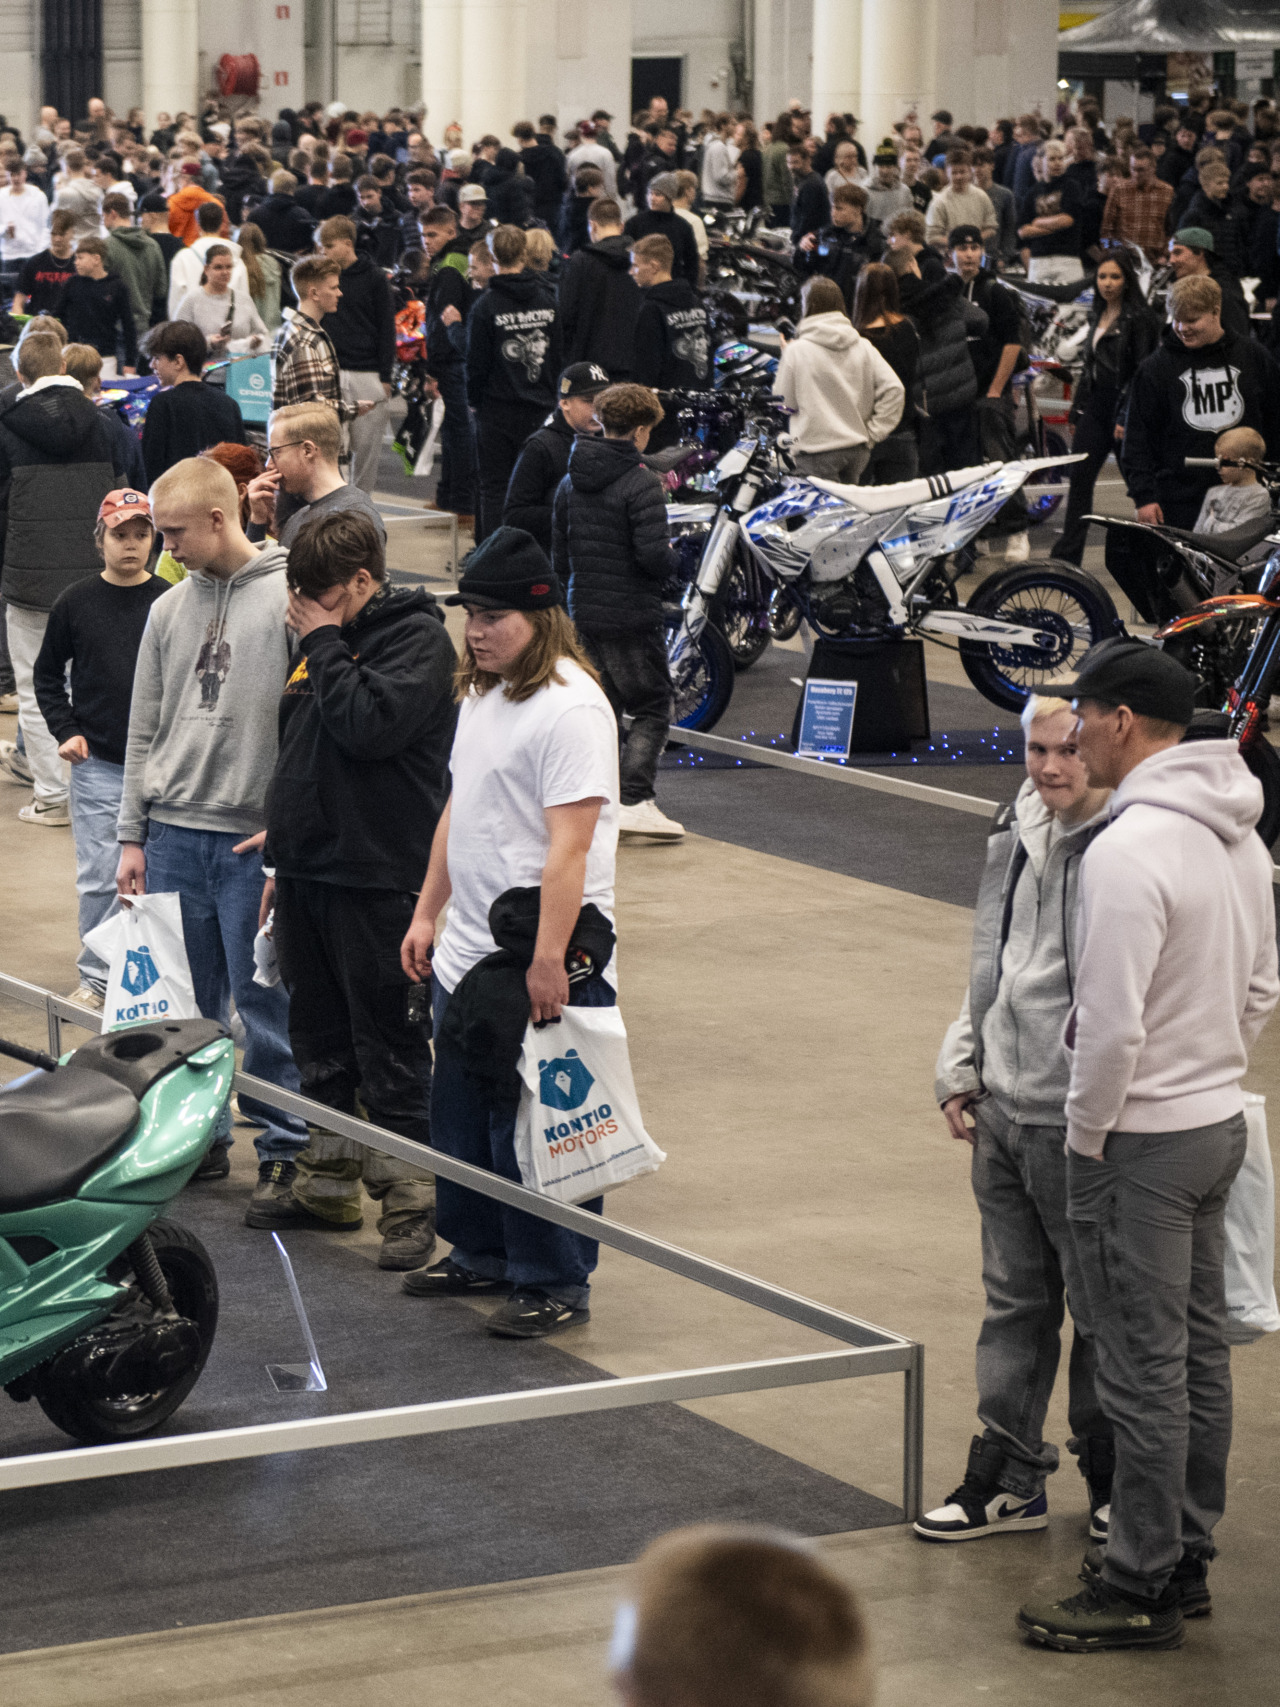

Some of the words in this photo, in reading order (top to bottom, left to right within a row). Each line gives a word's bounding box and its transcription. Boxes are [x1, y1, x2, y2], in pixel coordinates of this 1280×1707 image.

[589, 364, 609, 382] NY
[1193, 381, 1233, 415] MP
[543, 1103, 613, 1143] KONTIO
[547, 1119, 619, 1159] MOTORS
